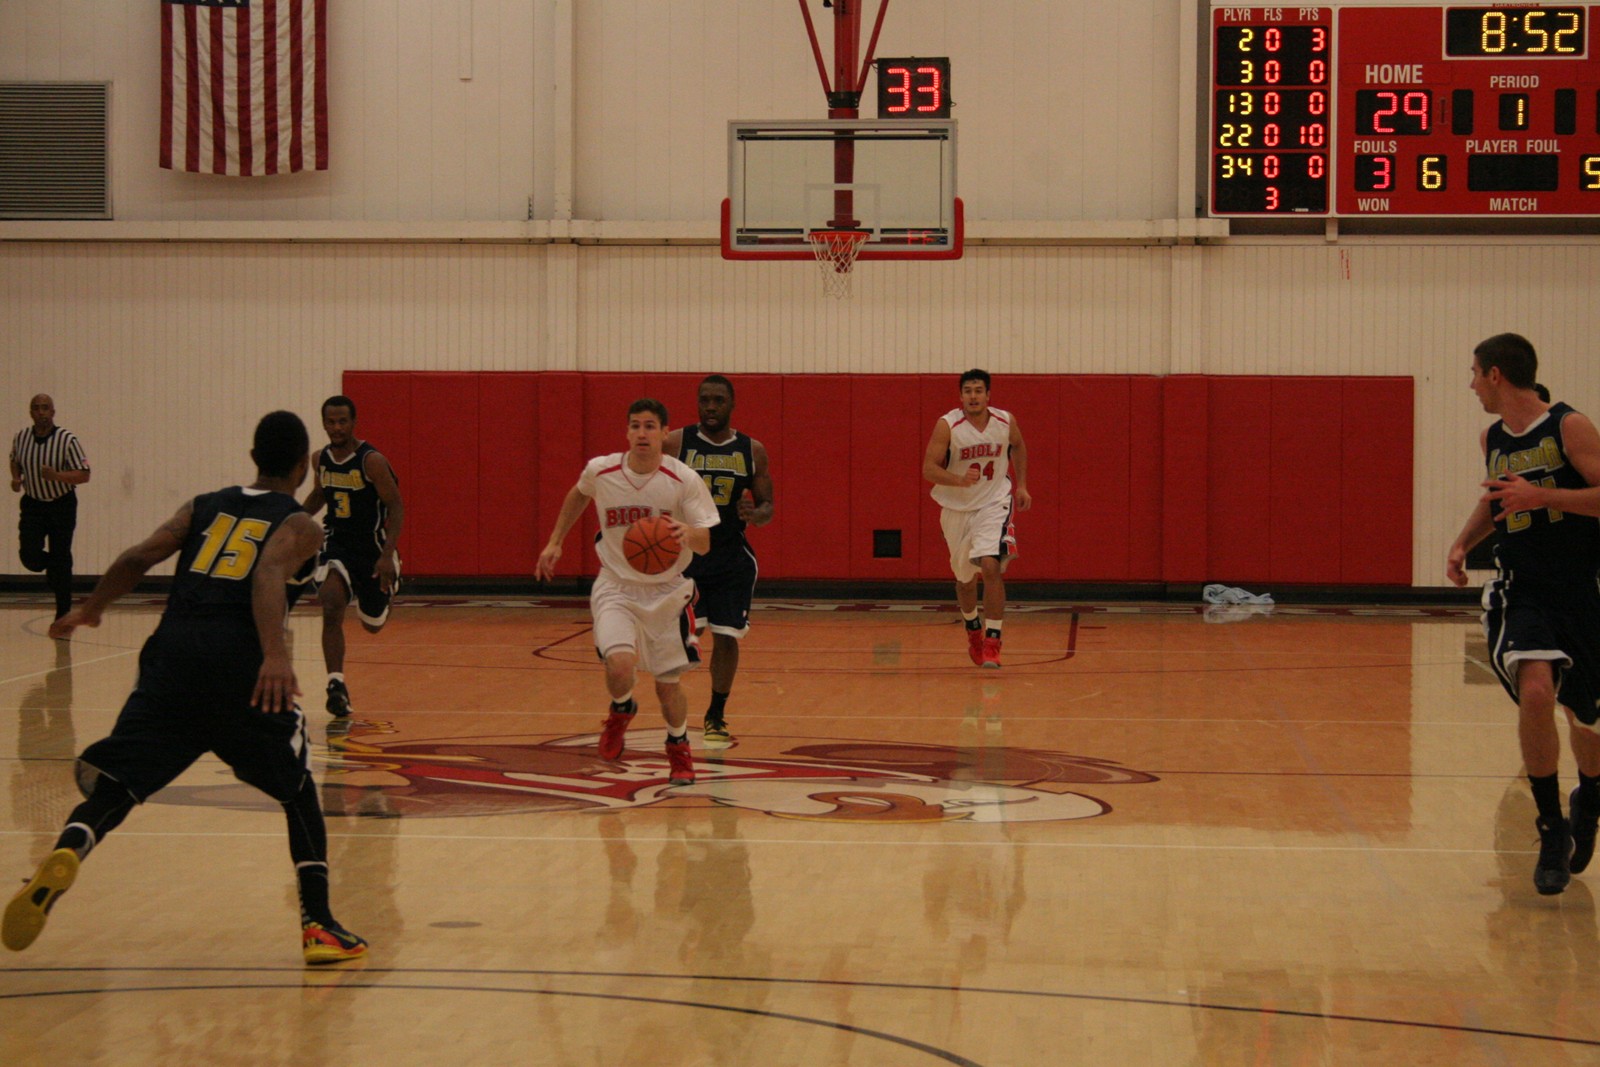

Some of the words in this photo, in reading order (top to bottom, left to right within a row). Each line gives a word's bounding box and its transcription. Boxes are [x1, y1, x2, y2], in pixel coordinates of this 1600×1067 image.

[1224, 8, 1250, 21] PLYR
[1264, 8, 1282, 21] FLS
[1300, 8, 1318, 20] PTS
[1239, 29, 1254, 51] 2
[1265, 28, 1281, 52] 0
[1312, 28, 1325, 52] 3
[1482, 12, 1578, 52] 8:52
[1241, 60, 1253, 83] 3
[1264, 60, 1281, 84] 0
[1309, 60, 1325, 84] 0
[1366, 64, 1422, 83] HOME
[1491, 76, 1539, 88] PERIOD
[887, 66, 942, 113] 33
[1230, 92, 1252, 115] 13
[1264, 92, 1280, 115] 0
[1308, 91, 1325, 115] 0
[1373, 92, 1428, 133] 29
[1517, 98, 1525, 126] 1
[1220, 124, 1252, 146] 22
[1264, 123, 1280, 146] 0
[1300, 123, 1324, 146] 10
[1466, 140, 1517, 152] PLAYER
[1527, 140, 1560, 152] FOUL
[1354, 141, 1396, 153] FOULS
[1222, 155, 1252, 178] 34
[1264, 155, 1280, 178] 0
[1308, 155, 1324, 178] 0
[1373, 157, 1390, 189] 3
[1423, 158, 1441, 188] 6
[1266, 186, 1279, 210] 3
[1358, 198, 1389, 211] WON
[1490, 198, 1536, 211] MATCH
[334, 491, 351, 518] 3
[189, 511, 273, 580] 15
